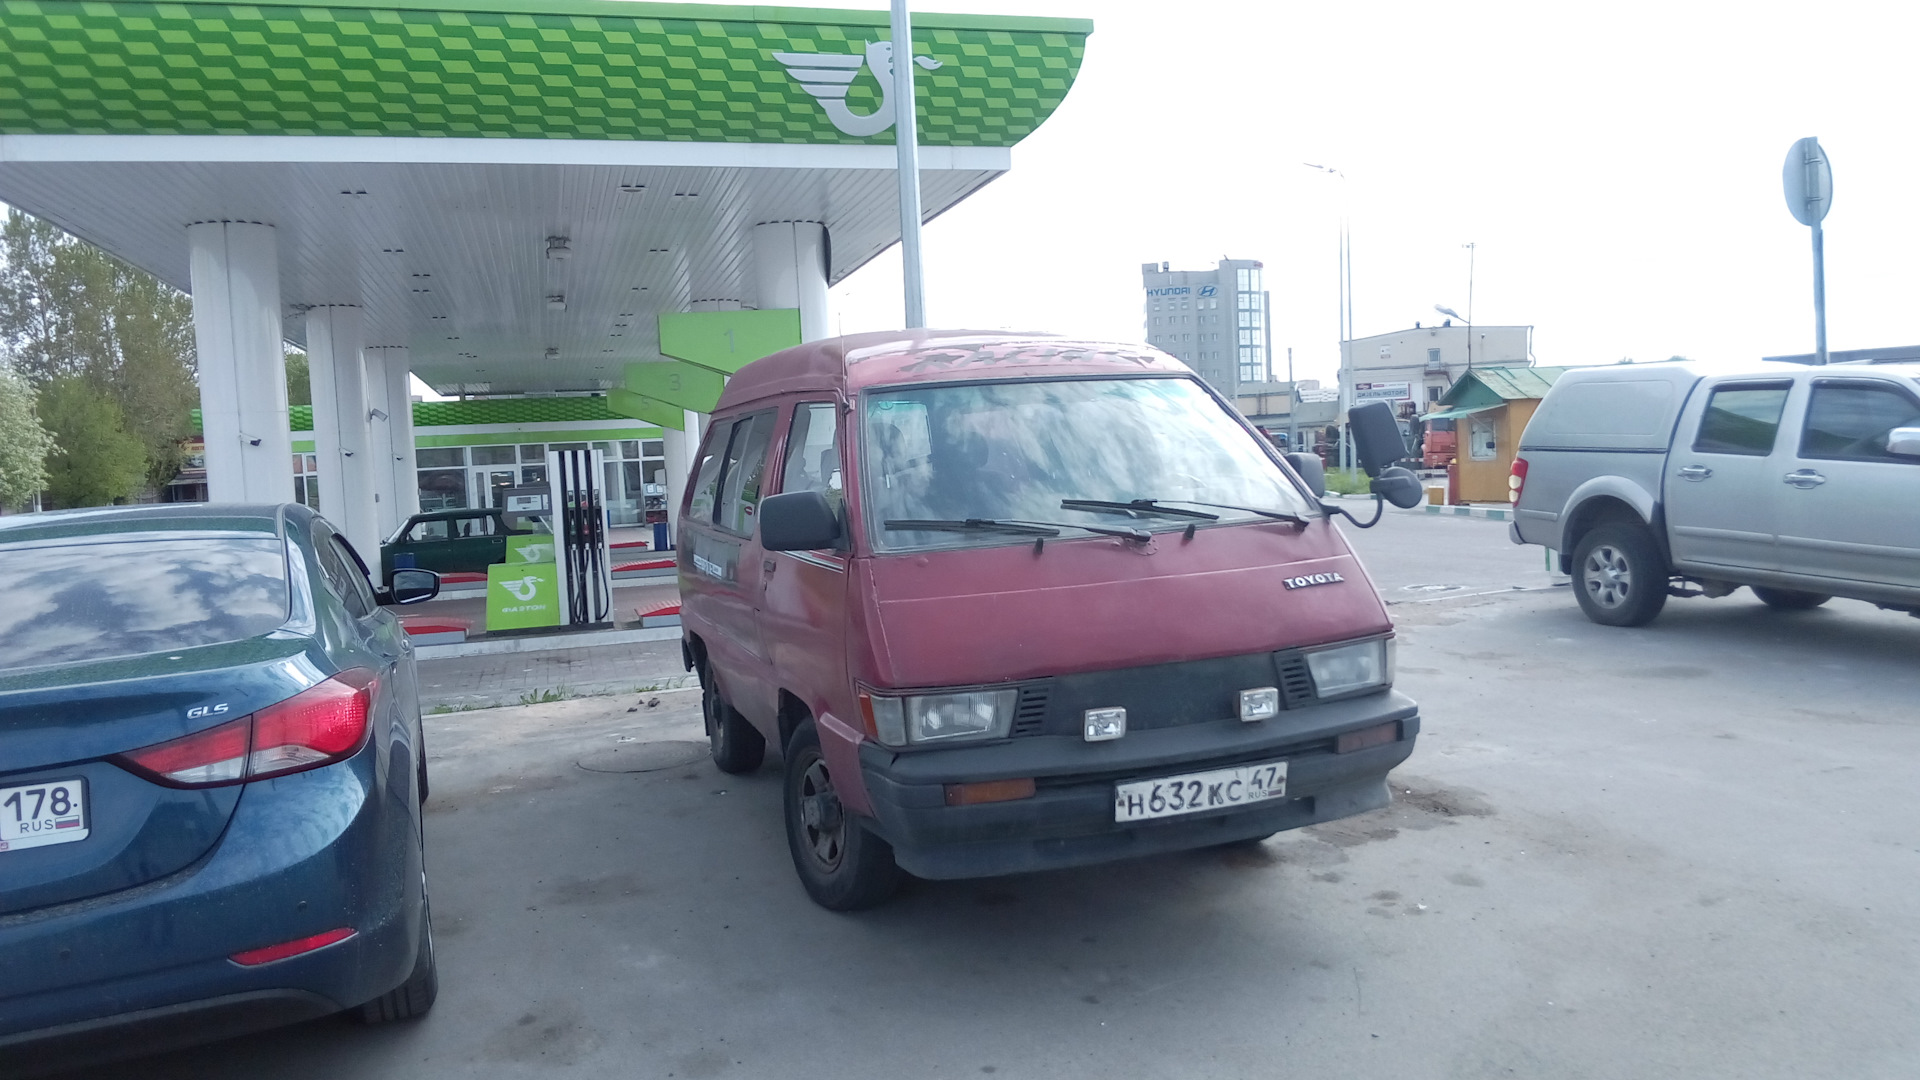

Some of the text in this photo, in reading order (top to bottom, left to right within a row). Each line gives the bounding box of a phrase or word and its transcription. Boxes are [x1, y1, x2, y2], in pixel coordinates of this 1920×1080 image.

[1147, 287, 1191, 296] HYUNDAI
[724, 328, 735, 353] 1
[669, 373, 682, 391] 3
[1284, 572, 1345, 588] TOYOTA
[186, 703, 229, 719] GLS
[1251, 767, 1277, 790] 47
[1248, 789, 1268, 799] RUS
[3, 786, 71, 822] 178
[20, 819, 53, 834] RUS
